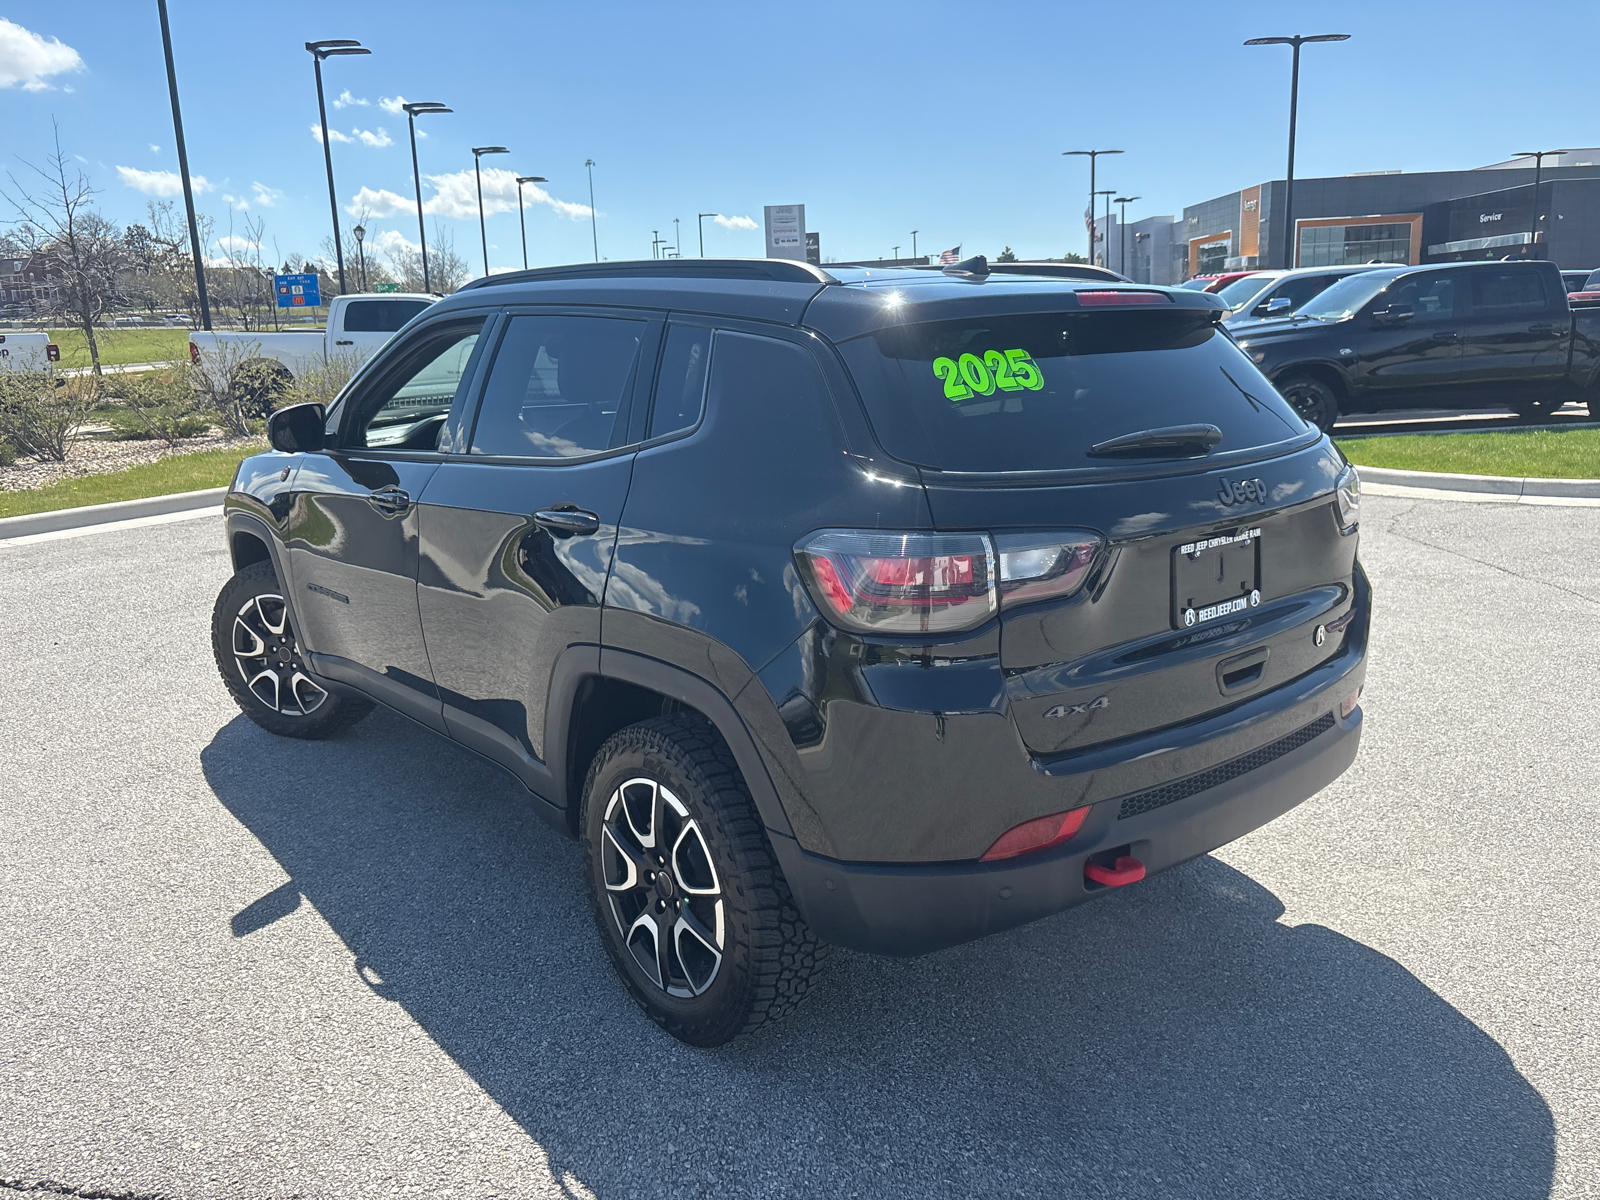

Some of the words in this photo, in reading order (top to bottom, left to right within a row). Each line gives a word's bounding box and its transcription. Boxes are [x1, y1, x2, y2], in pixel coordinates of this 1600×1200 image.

[1480, 212, 1503, 223] Service
[932, 348, 1045, 402] 2025
[1216, 476, 1268, 507] Jeep
[1181, 543, 1195, 555] REED
[1195, 540, 1208, 551] JEEP
[1249, 528, 1261, 538] RAM
[1199, 597, 1247, 622] REEDJEEP.COM
[1043, 694, 1110, 718] 4x4
